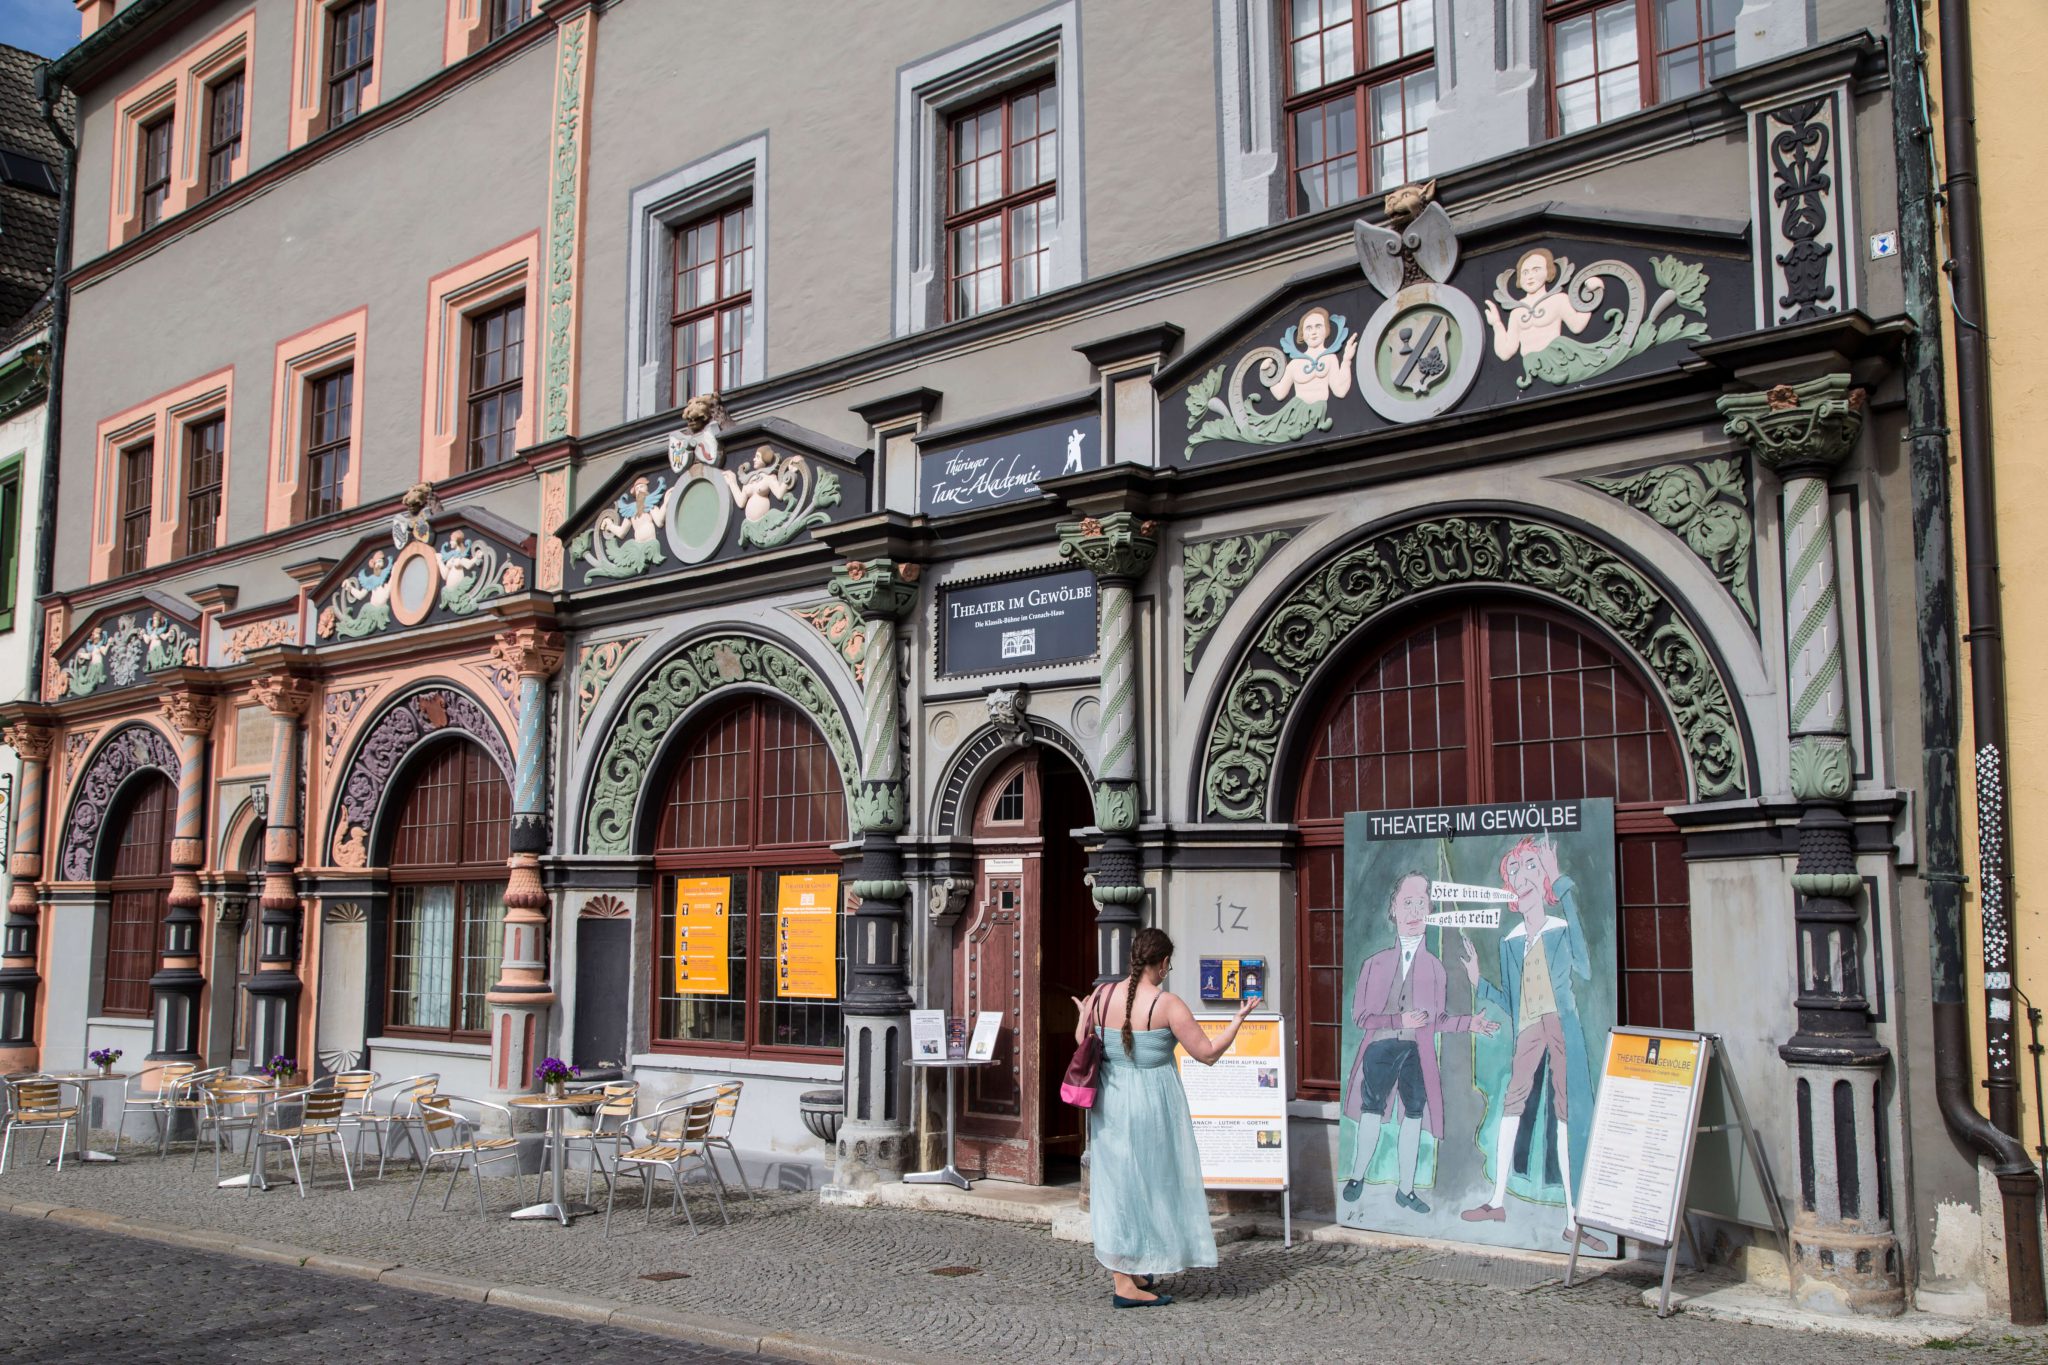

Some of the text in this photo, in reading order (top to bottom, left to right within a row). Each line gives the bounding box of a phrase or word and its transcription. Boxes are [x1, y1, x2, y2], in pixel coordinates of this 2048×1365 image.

[945, 449, 989, 483] Thüringer
[1028, 609, 1065, 620] Cranach-Haus
[1371, 804, 1577, 836] THEATER IM GEWÖLBE
[1432, 885, 1458, 899] Hier
[1480, 888, 1491, 899] ich
[1455, 913, 1467, 925] ich
[1468, 911, 1499, 924] rein!
[1617, 1054, 1645, 1064] THEATER
